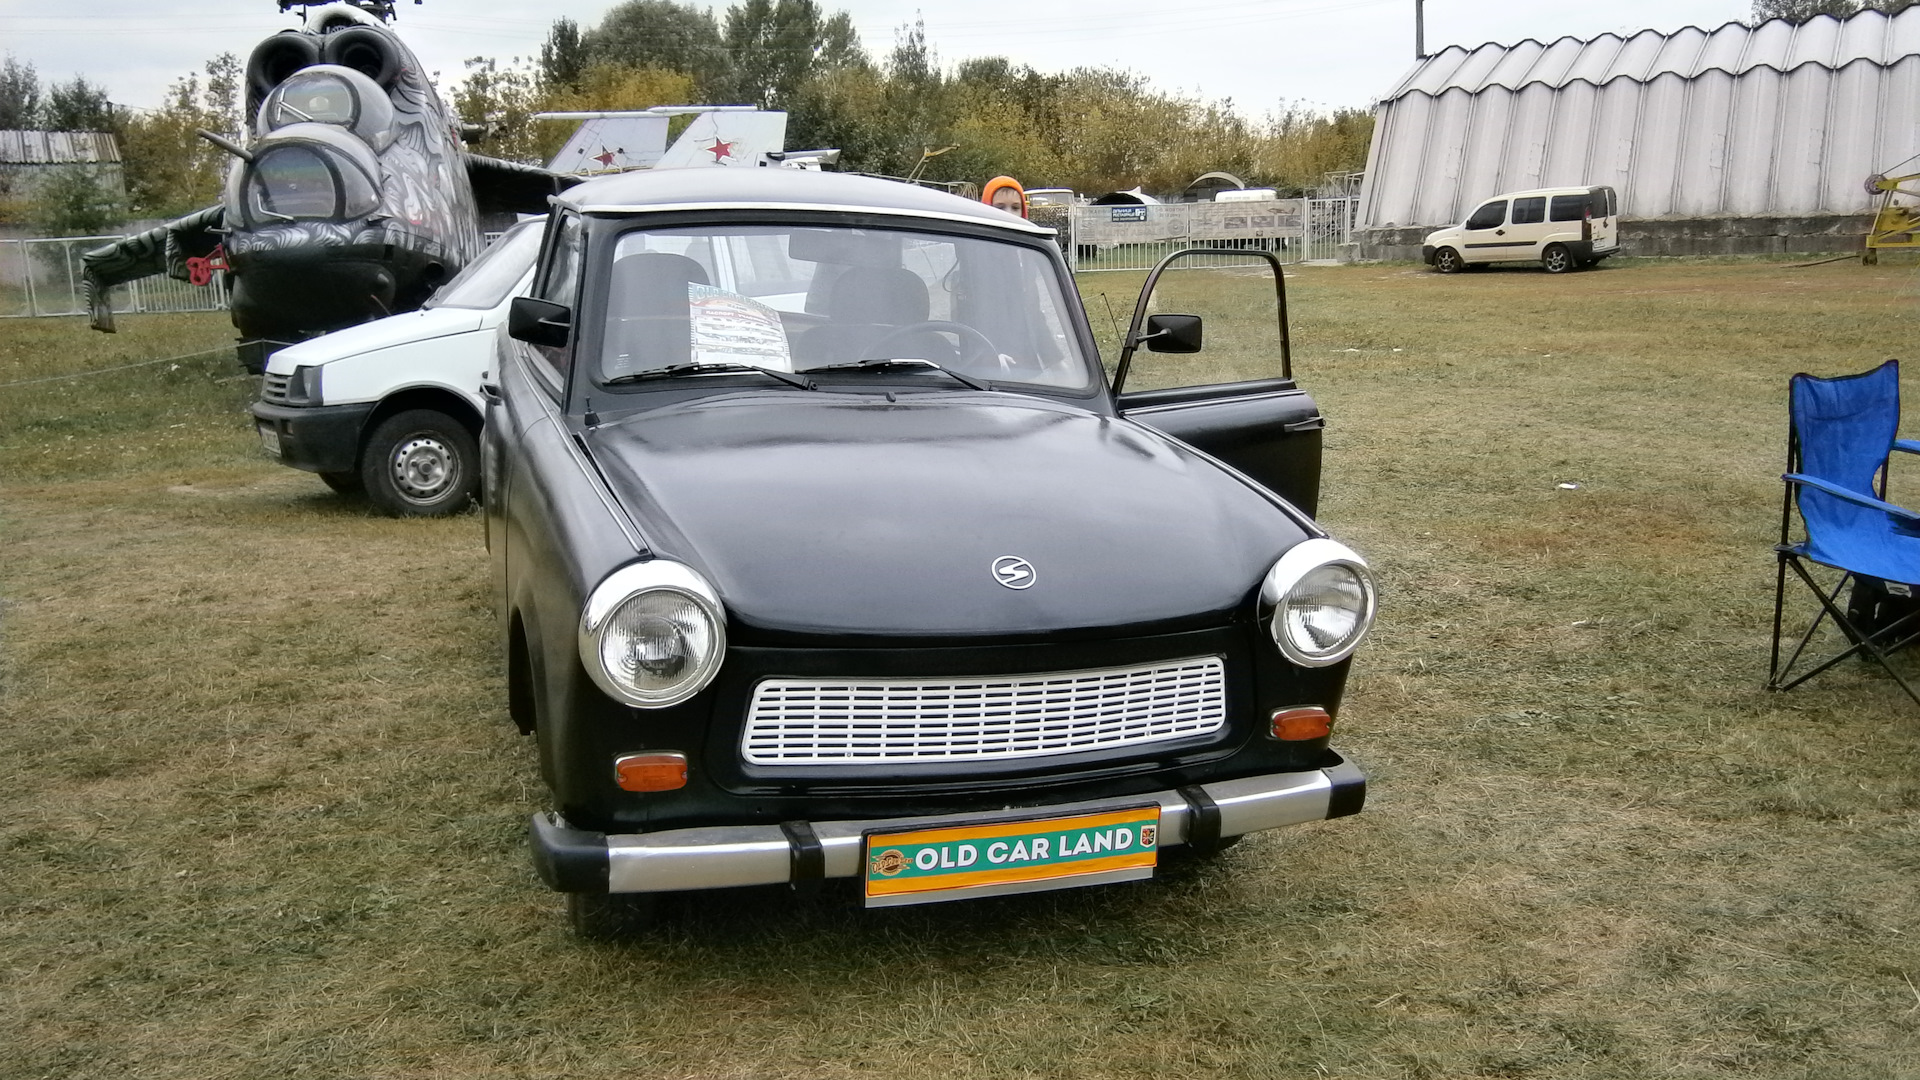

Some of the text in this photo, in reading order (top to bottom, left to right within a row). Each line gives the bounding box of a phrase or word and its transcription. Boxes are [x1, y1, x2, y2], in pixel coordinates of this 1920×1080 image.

[915, 828, 1133, 870] OLD CAR LAND
